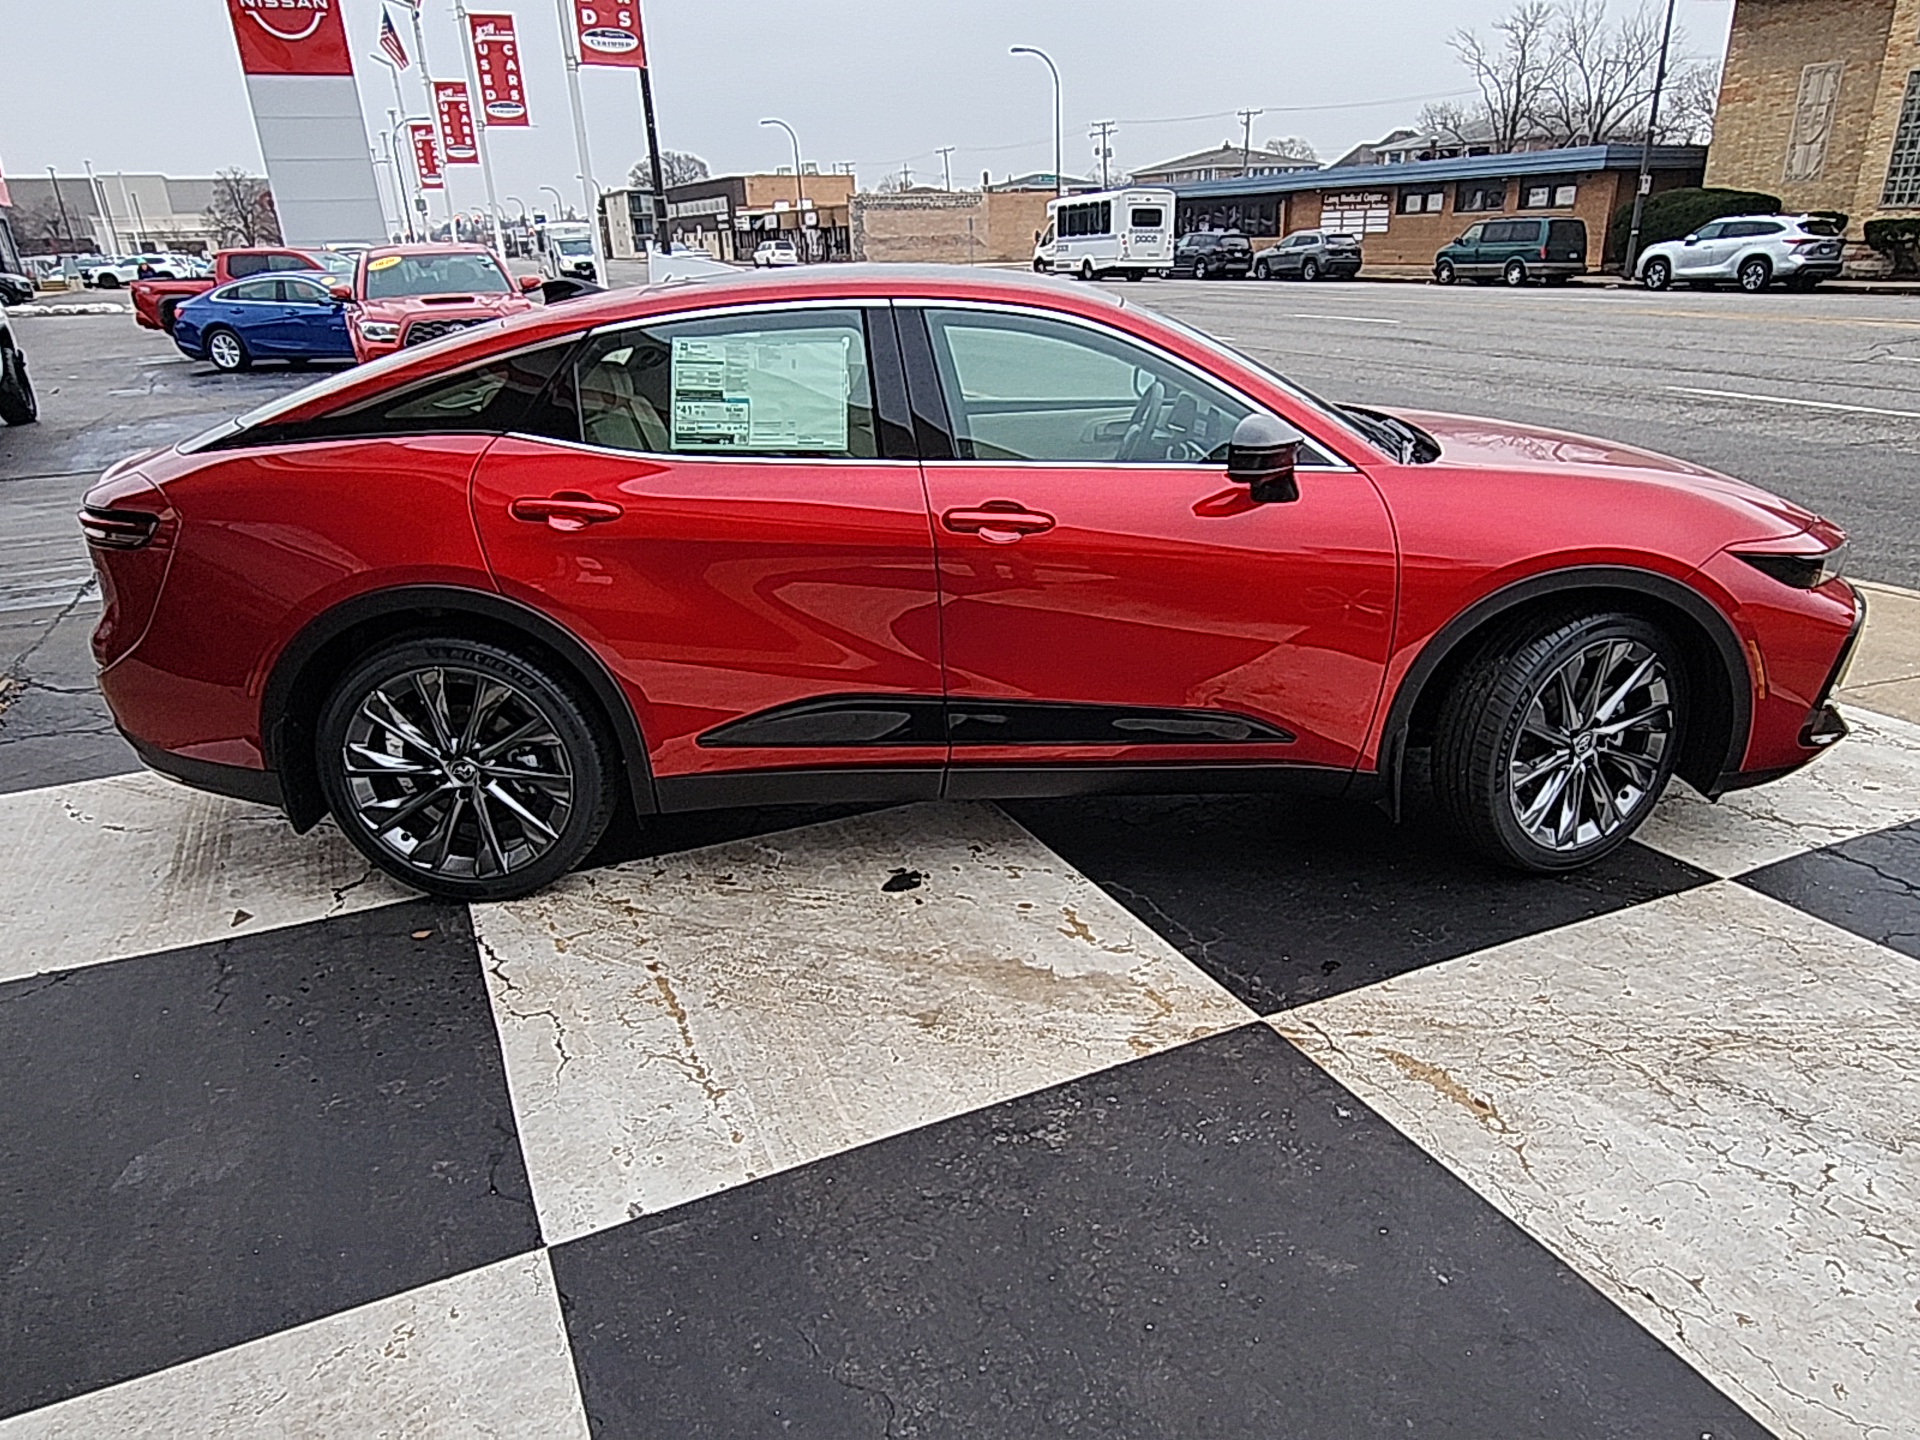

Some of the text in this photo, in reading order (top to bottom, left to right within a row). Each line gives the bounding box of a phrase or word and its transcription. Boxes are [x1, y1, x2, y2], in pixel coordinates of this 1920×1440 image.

[240, 0, 329, 9] NISSAN
[477, 43, 497, 100] USED
[502, 43, 520, 100] CARS
[450, 649, 535, 687] MICHELIN
[1497, 691, 1529, 772] MICHELIN
